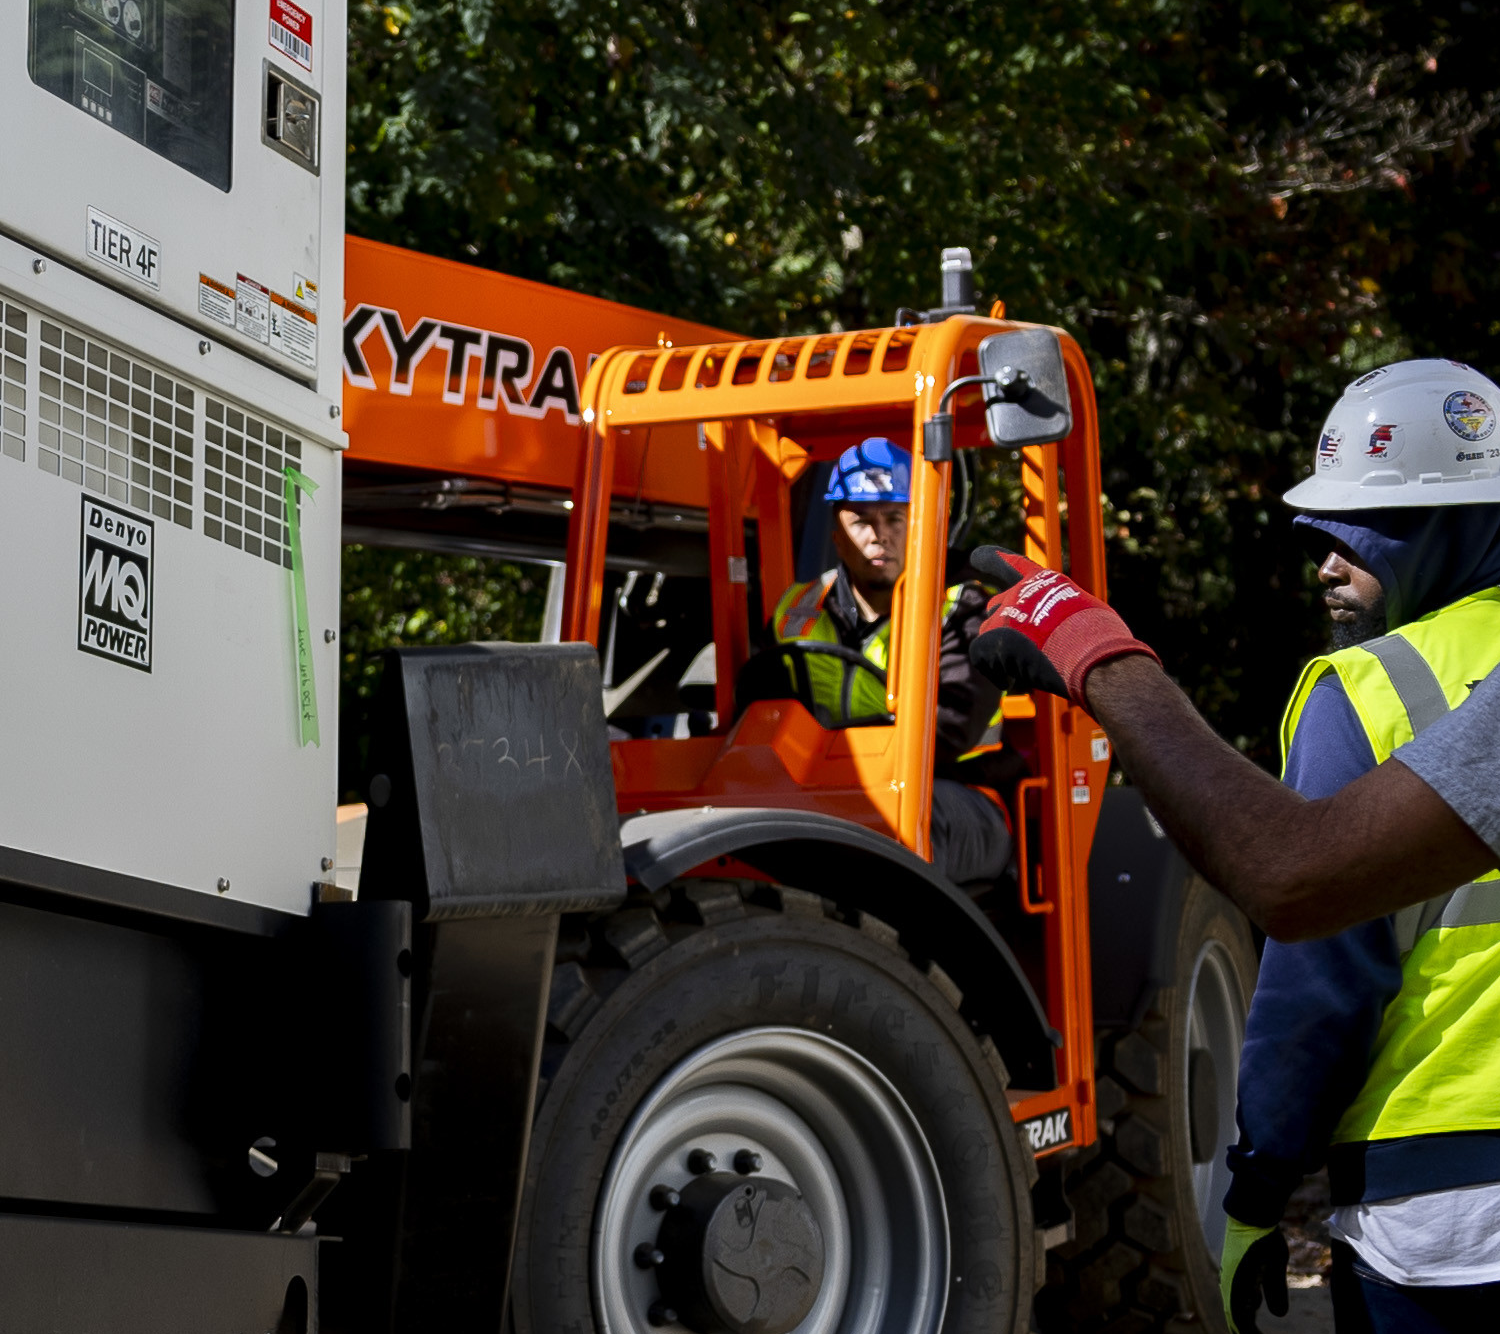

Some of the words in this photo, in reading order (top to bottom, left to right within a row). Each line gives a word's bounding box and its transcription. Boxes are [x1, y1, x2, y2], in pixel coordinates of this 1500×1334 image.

[91, 218, 131, 266] TIER
[136, 242, 158, 279] 4F
[89, 508, 147, 546] Denyo
[84, 548, 148, 629] MQ
[84, 619, 147, 662] POWER
